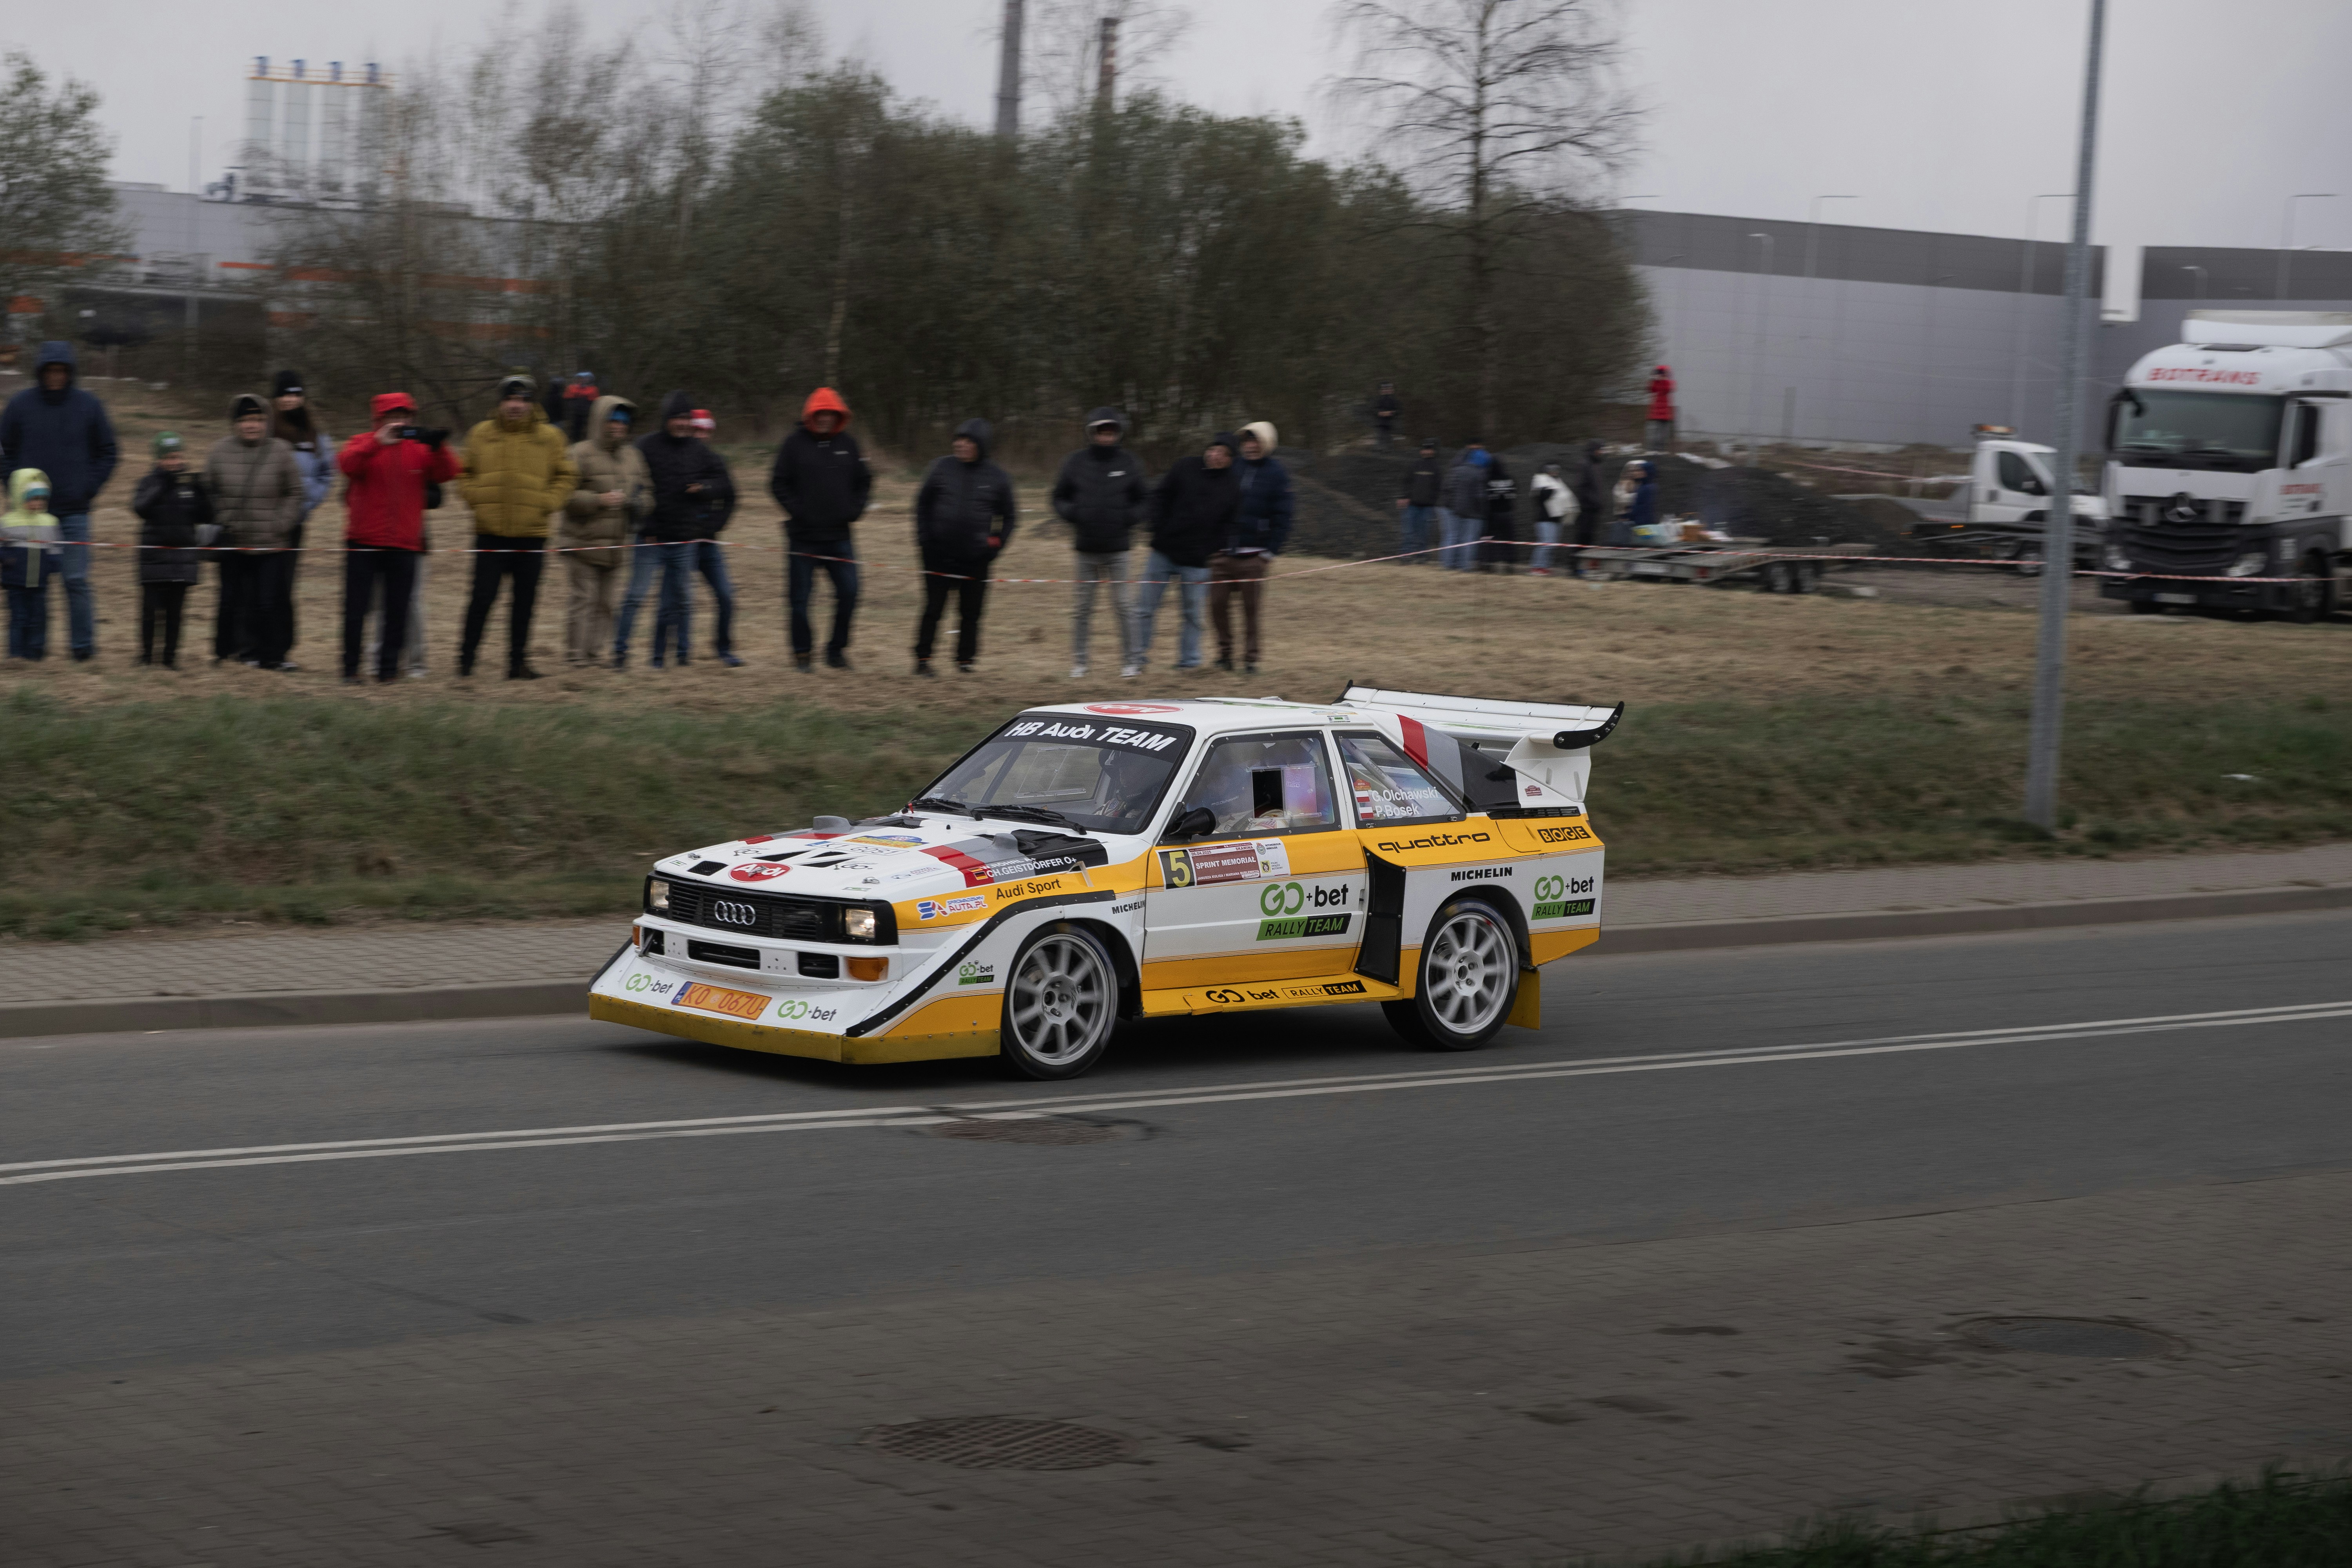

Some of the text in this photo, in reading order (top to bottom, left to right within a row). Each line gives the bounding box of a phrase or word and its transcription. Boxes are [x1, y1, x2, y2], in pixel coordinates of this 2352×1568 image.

[1004, 722, 1177, 751] HB Audi TEAM
[1372, 786, 1438, 802] G.Olchawski
[1375, 804, 1420, 817] P.Bosek
[1377, 832, 1490, 853] quattro
[1538, 827, 1590, 842] BOGE
[986, 858, 1064, 877] CH.GEISTDÖRFER
[1169, 851, 1191, 887] 5
[1196, 857, 1256, 869] SPRINT MEMORIAŁ
[1451, 867, 1513, 881] MICHELIN
[996, 878, 1062, 900] Audi Sport
[949, 901, 986, 912] AUTA.PL
[1535, 902, 1590, 916] RALLY TEAM
[1265, 917, 1344, 936] RALLY TEAM
[1246, 989, 1280, 1000] bet
[1290, 987, 1323, 996] RALLY
[1326, 984, 1359, 994] TEAM
[718, 993, 765, 1015] 067U
